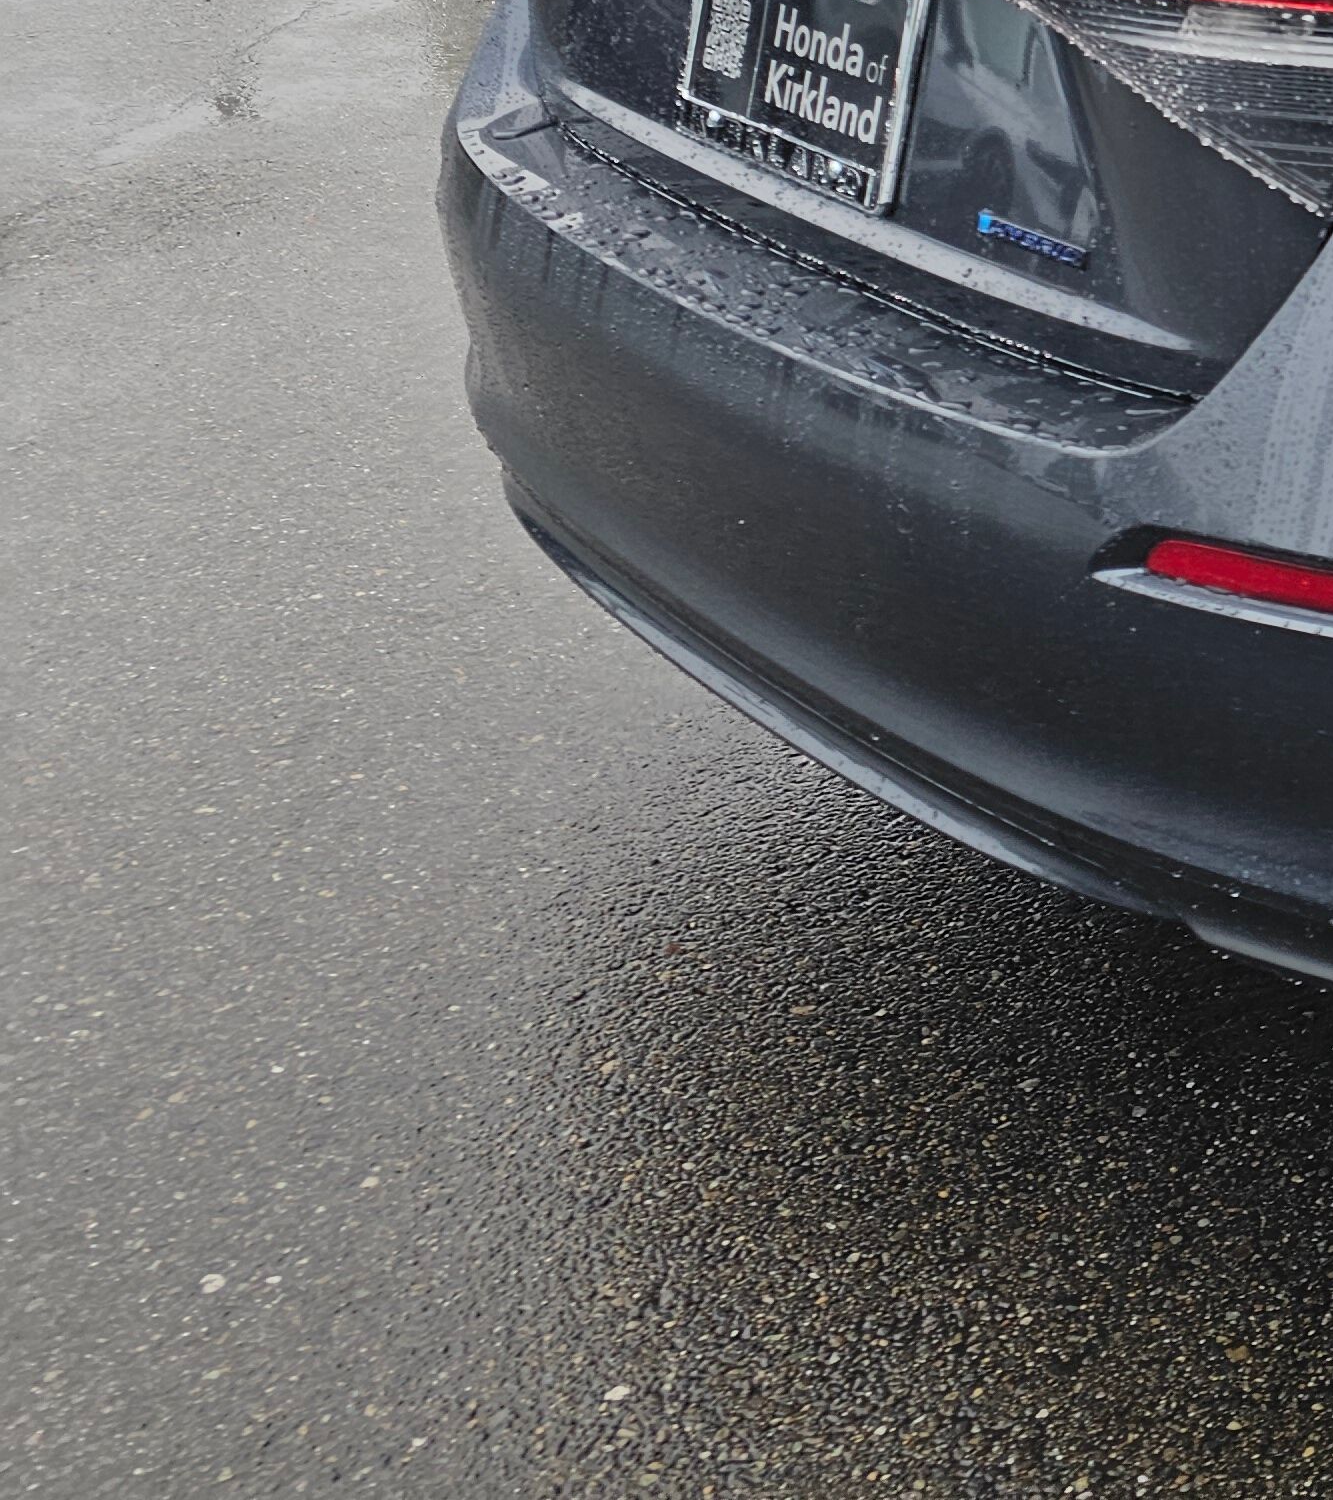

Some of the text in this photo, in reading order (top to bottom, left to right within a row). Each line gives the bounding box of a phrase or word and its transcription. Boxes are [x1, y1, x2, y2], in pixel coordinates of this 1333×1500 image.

[773, 3, 890, 86] Honda of
[764, 59, 883, 145] Kirkland
